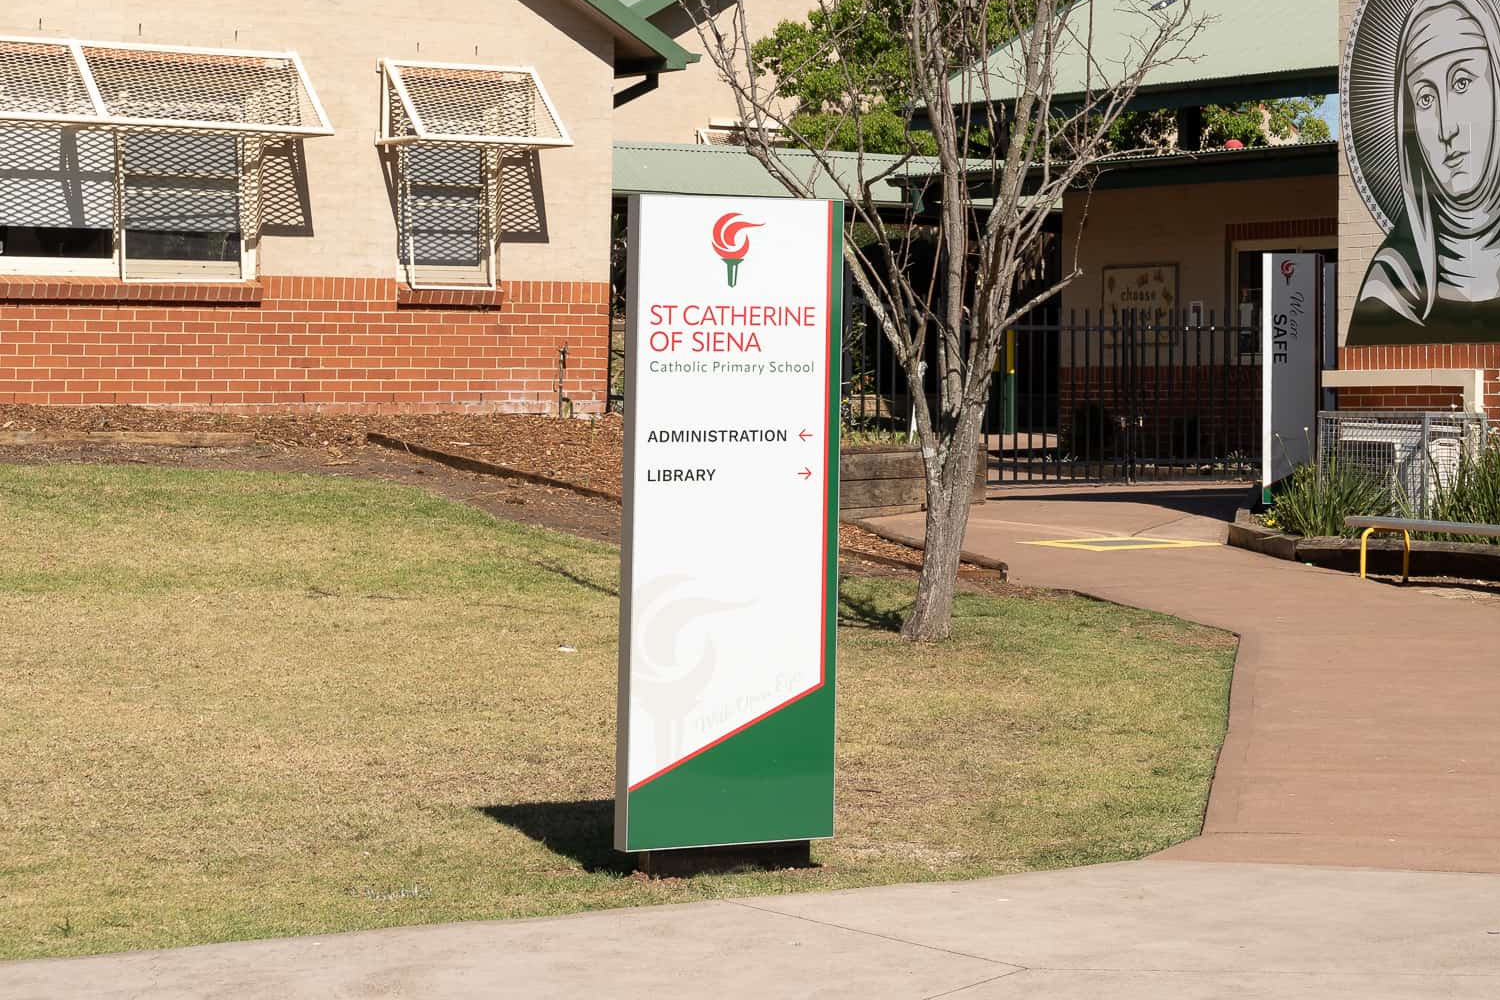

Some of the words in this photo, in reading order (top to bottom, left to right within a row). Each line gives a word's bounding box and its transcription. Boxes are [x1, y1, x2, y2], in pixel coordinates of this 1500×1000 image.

[650, 304, 678, 326] ST
[683, 304, 816, 327] CATHERINE
[650, 331, 683, 353] OF
[692, 331, 762, 353] SIENA
[1273, 314, 1288, 364] SAFE
[650, 360, 707, 373] Catholic
[713, 361, 764, 375] Primary
[770, 361, 814, 373] School
[648, 429, 787, 443] ADMINISTRATION
[648, 468, 716, 482] LIBRARY
